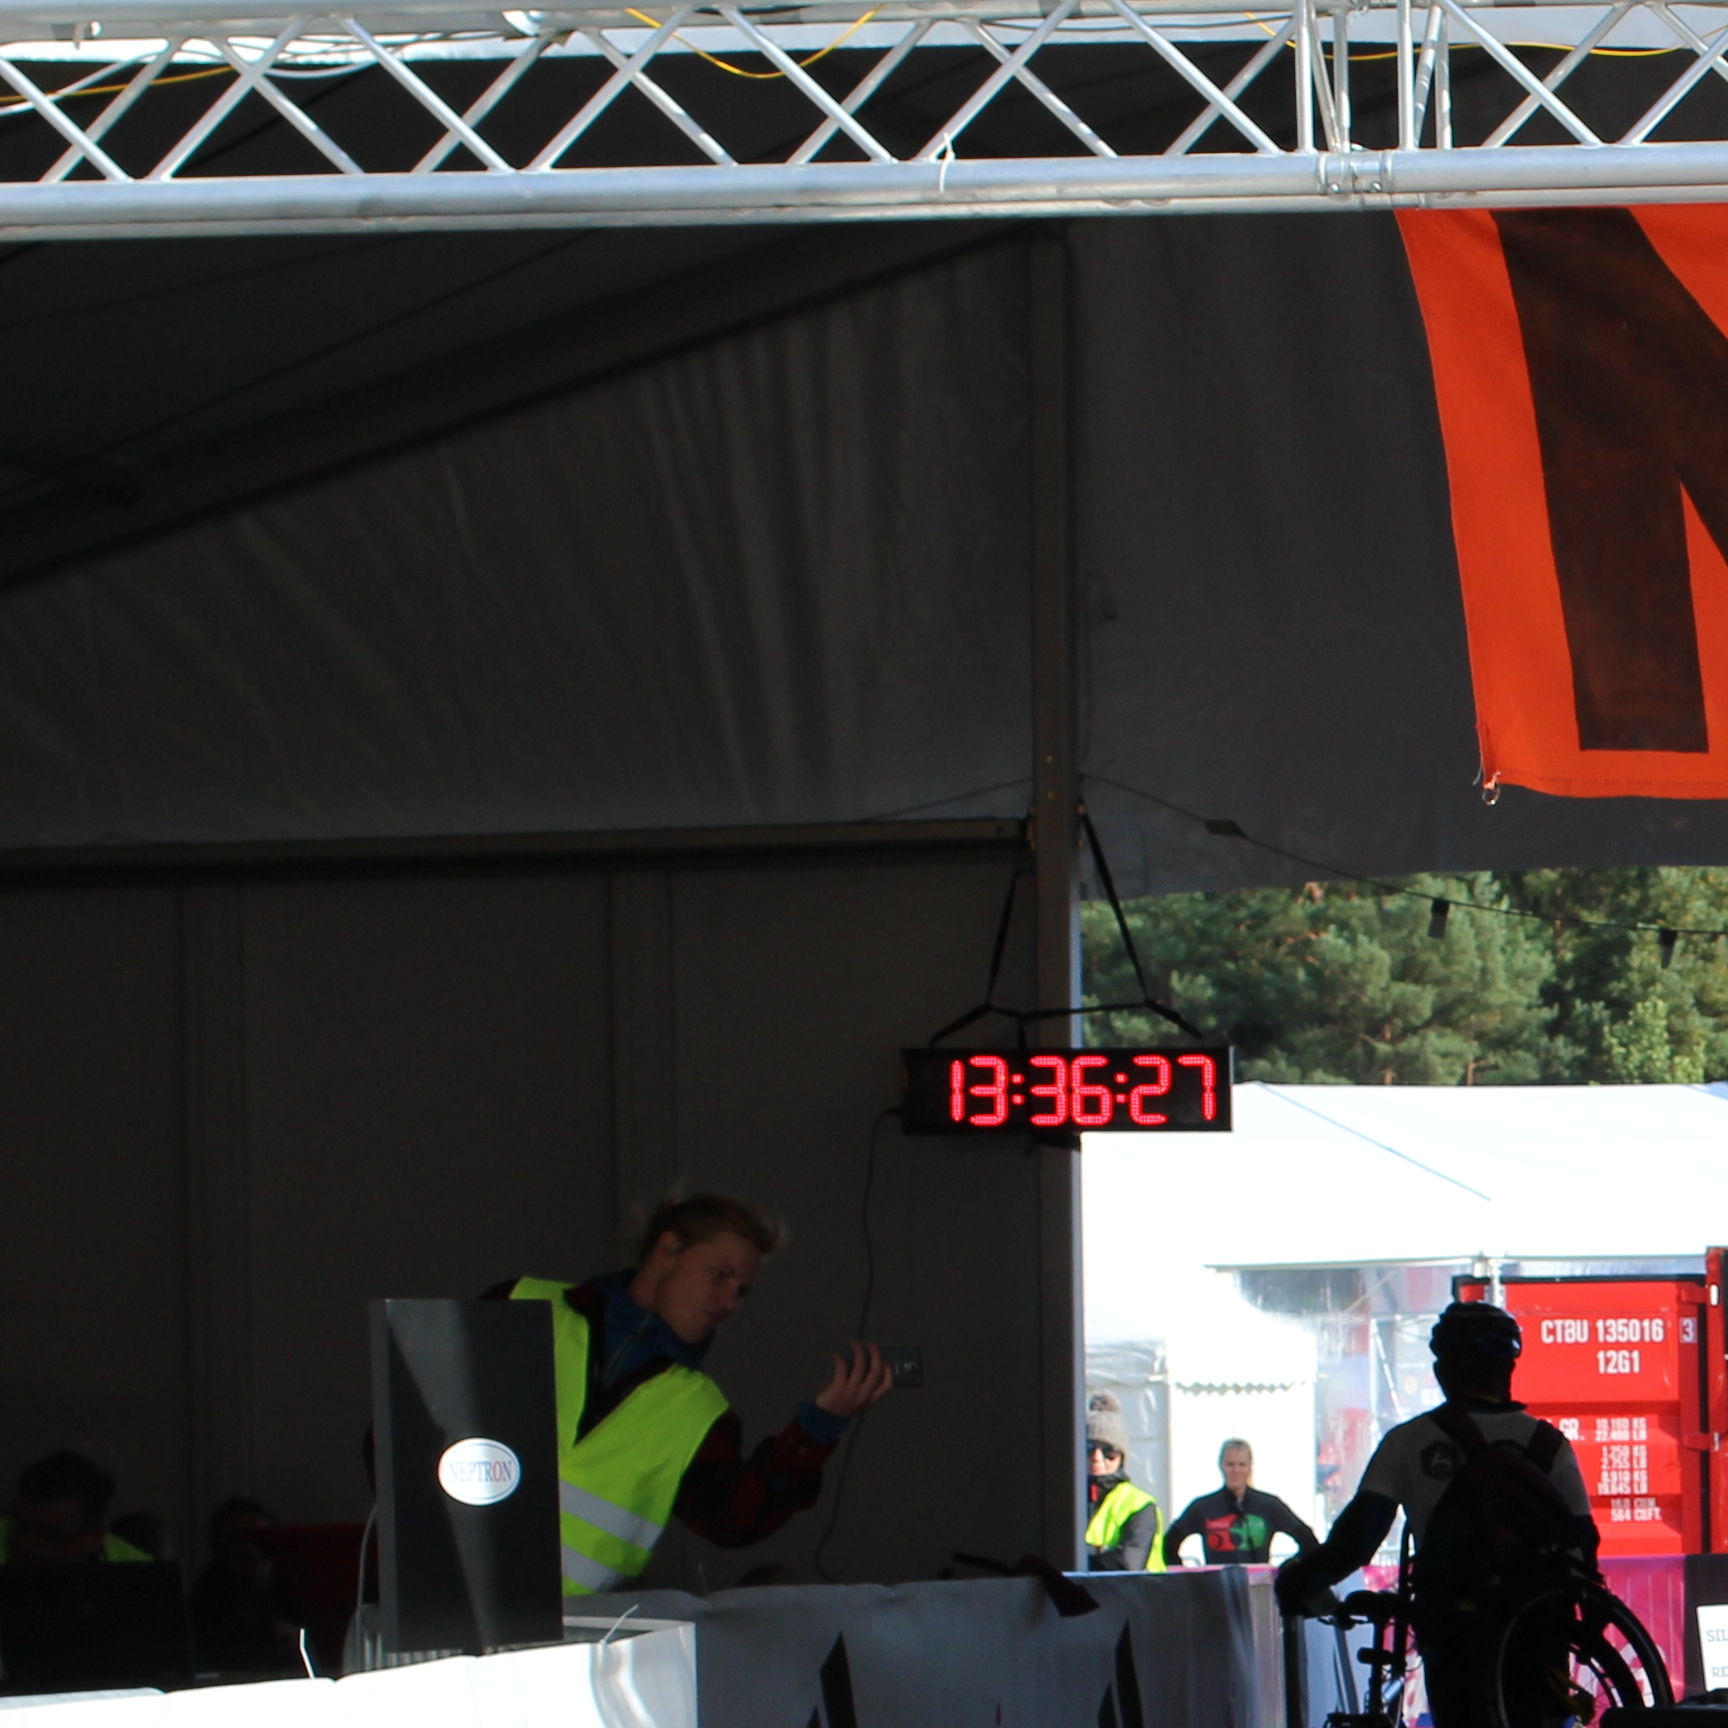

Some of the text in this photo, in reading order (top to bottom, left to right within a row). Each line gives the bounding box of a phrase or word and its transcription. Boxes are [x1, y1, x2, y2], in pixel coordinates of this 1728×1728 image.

[949, 1054, 1217, 1126] 13:36:27
[1541, 1318, 1693, 1343] CTBU 135016 3
[1596, 1350, 1640, 1374] 12G1
